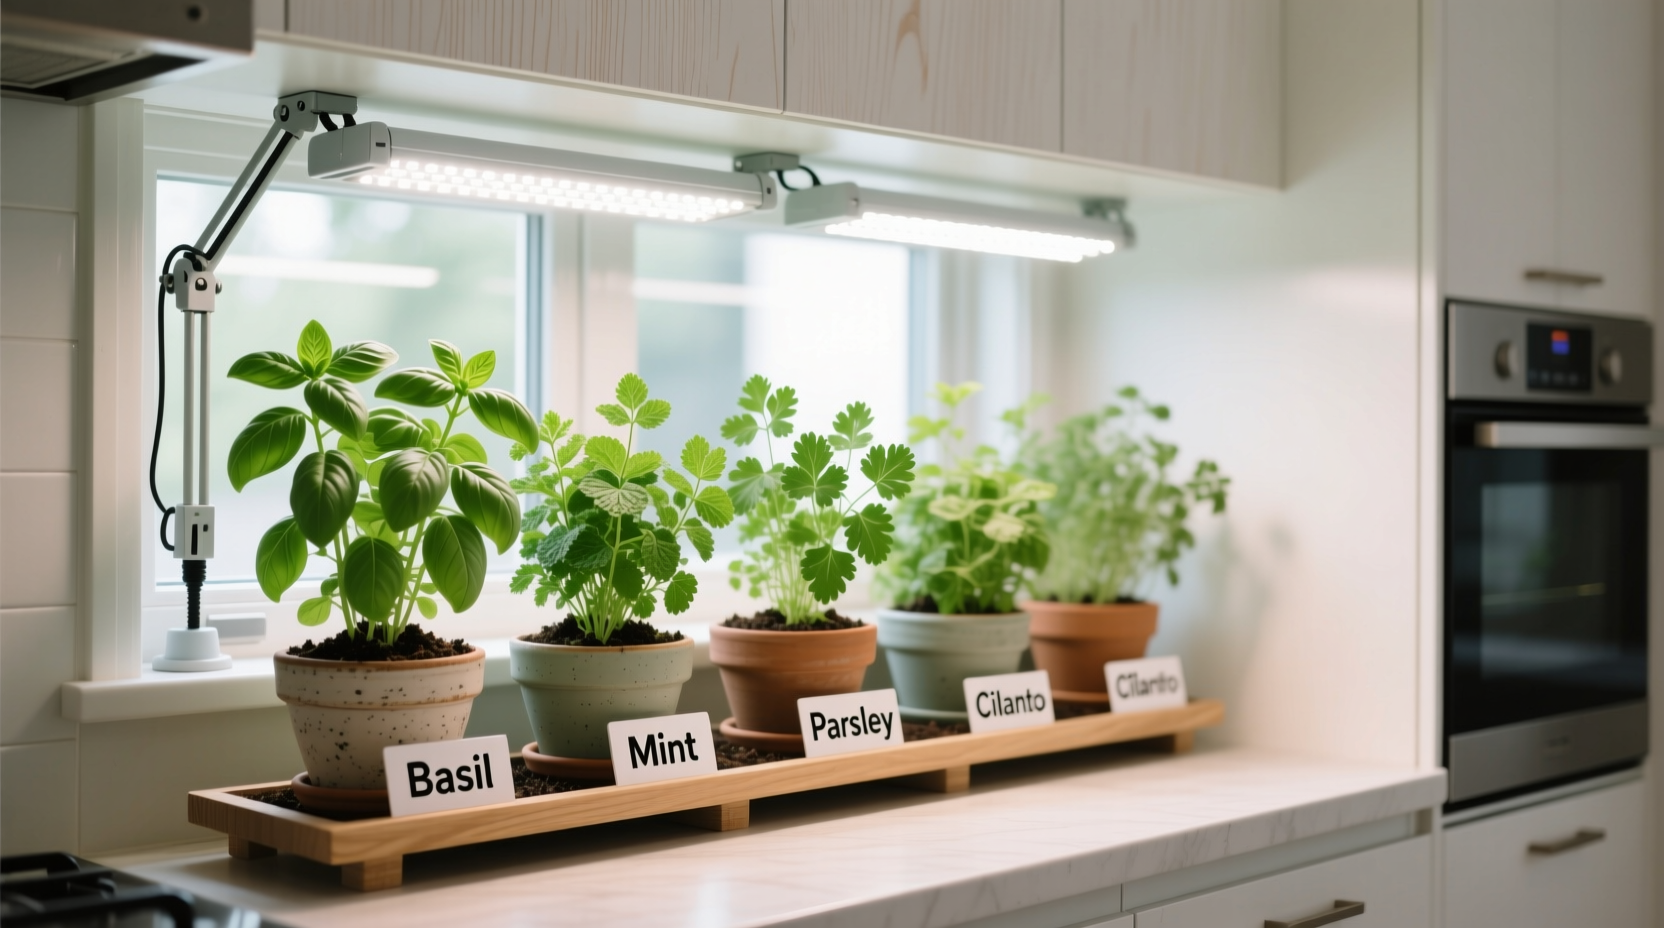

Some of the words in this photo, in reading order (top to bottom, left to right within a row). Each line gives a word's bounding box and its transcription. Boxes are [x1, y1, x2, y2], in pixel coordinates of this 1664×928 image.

[976, 689, 1046, 718] Cilanto
[810, 706, 894, 741] Parsley
[627, 732, 699, 769] Mint
[406, 752, 494, 798] Basil
